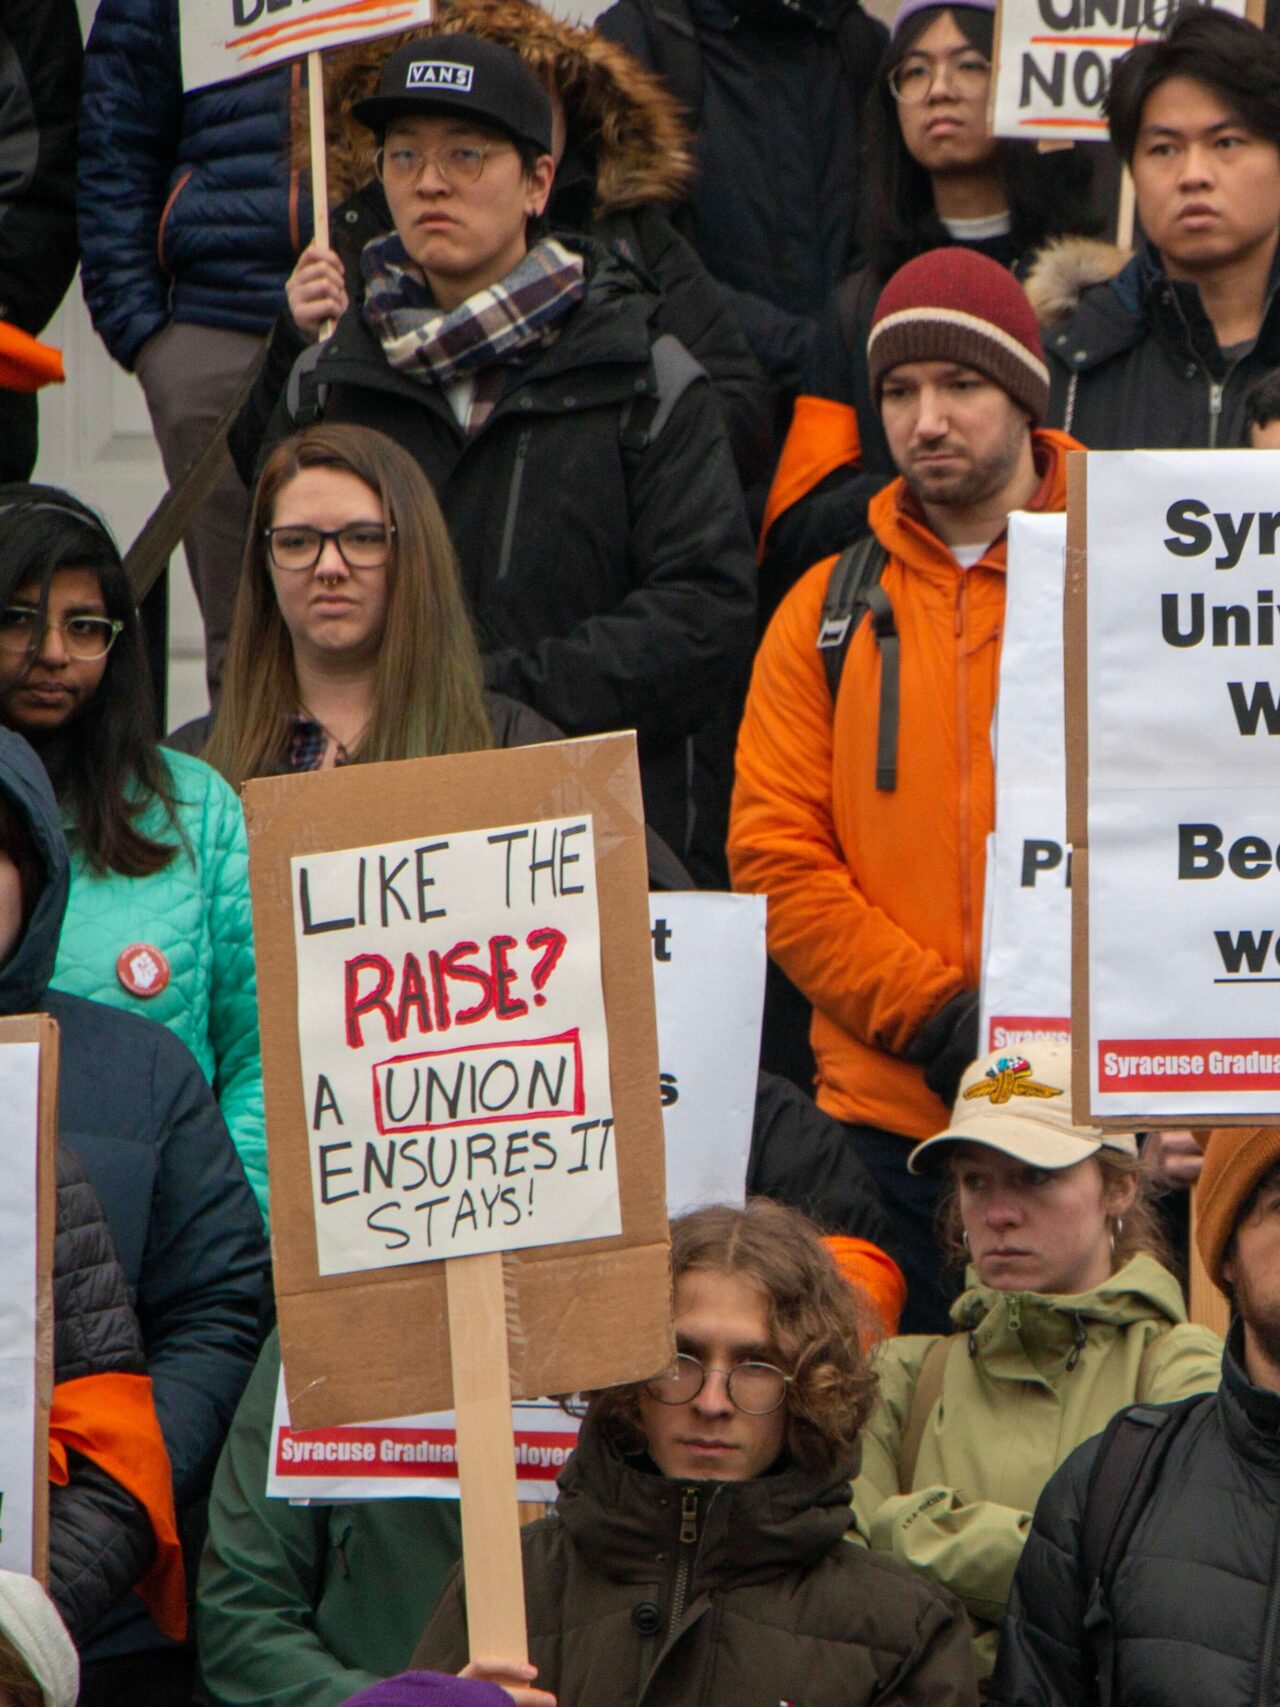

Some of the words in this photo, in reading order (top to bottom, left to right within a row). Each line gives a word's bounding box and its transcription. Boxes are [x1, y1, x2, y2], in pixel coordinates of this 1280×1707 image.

[1038, 0, 1170, 31] UNIO
[412, 65, 469, 86] VANS
[1019, 50, 1106, 107] NO
[300, 842, 449, 935] LIKE
[487, 825, 586, 907] THE
[344, 926, 568, 1050] RAISE?
[313, 1074, 344, 1130] A
[386, 1056, 567, 1122] UNION
[1103, 1051, 1204, 1077] Syracuse
[319, 1130, 558, 1205] ENSURES
[567, 1118, 615, 1174] IT
[366, 1177, 535, 1250] STAYS!
[281, 1437, 376, 1462] Syracuse
[380, 1439, 458, 1463] Gradua
